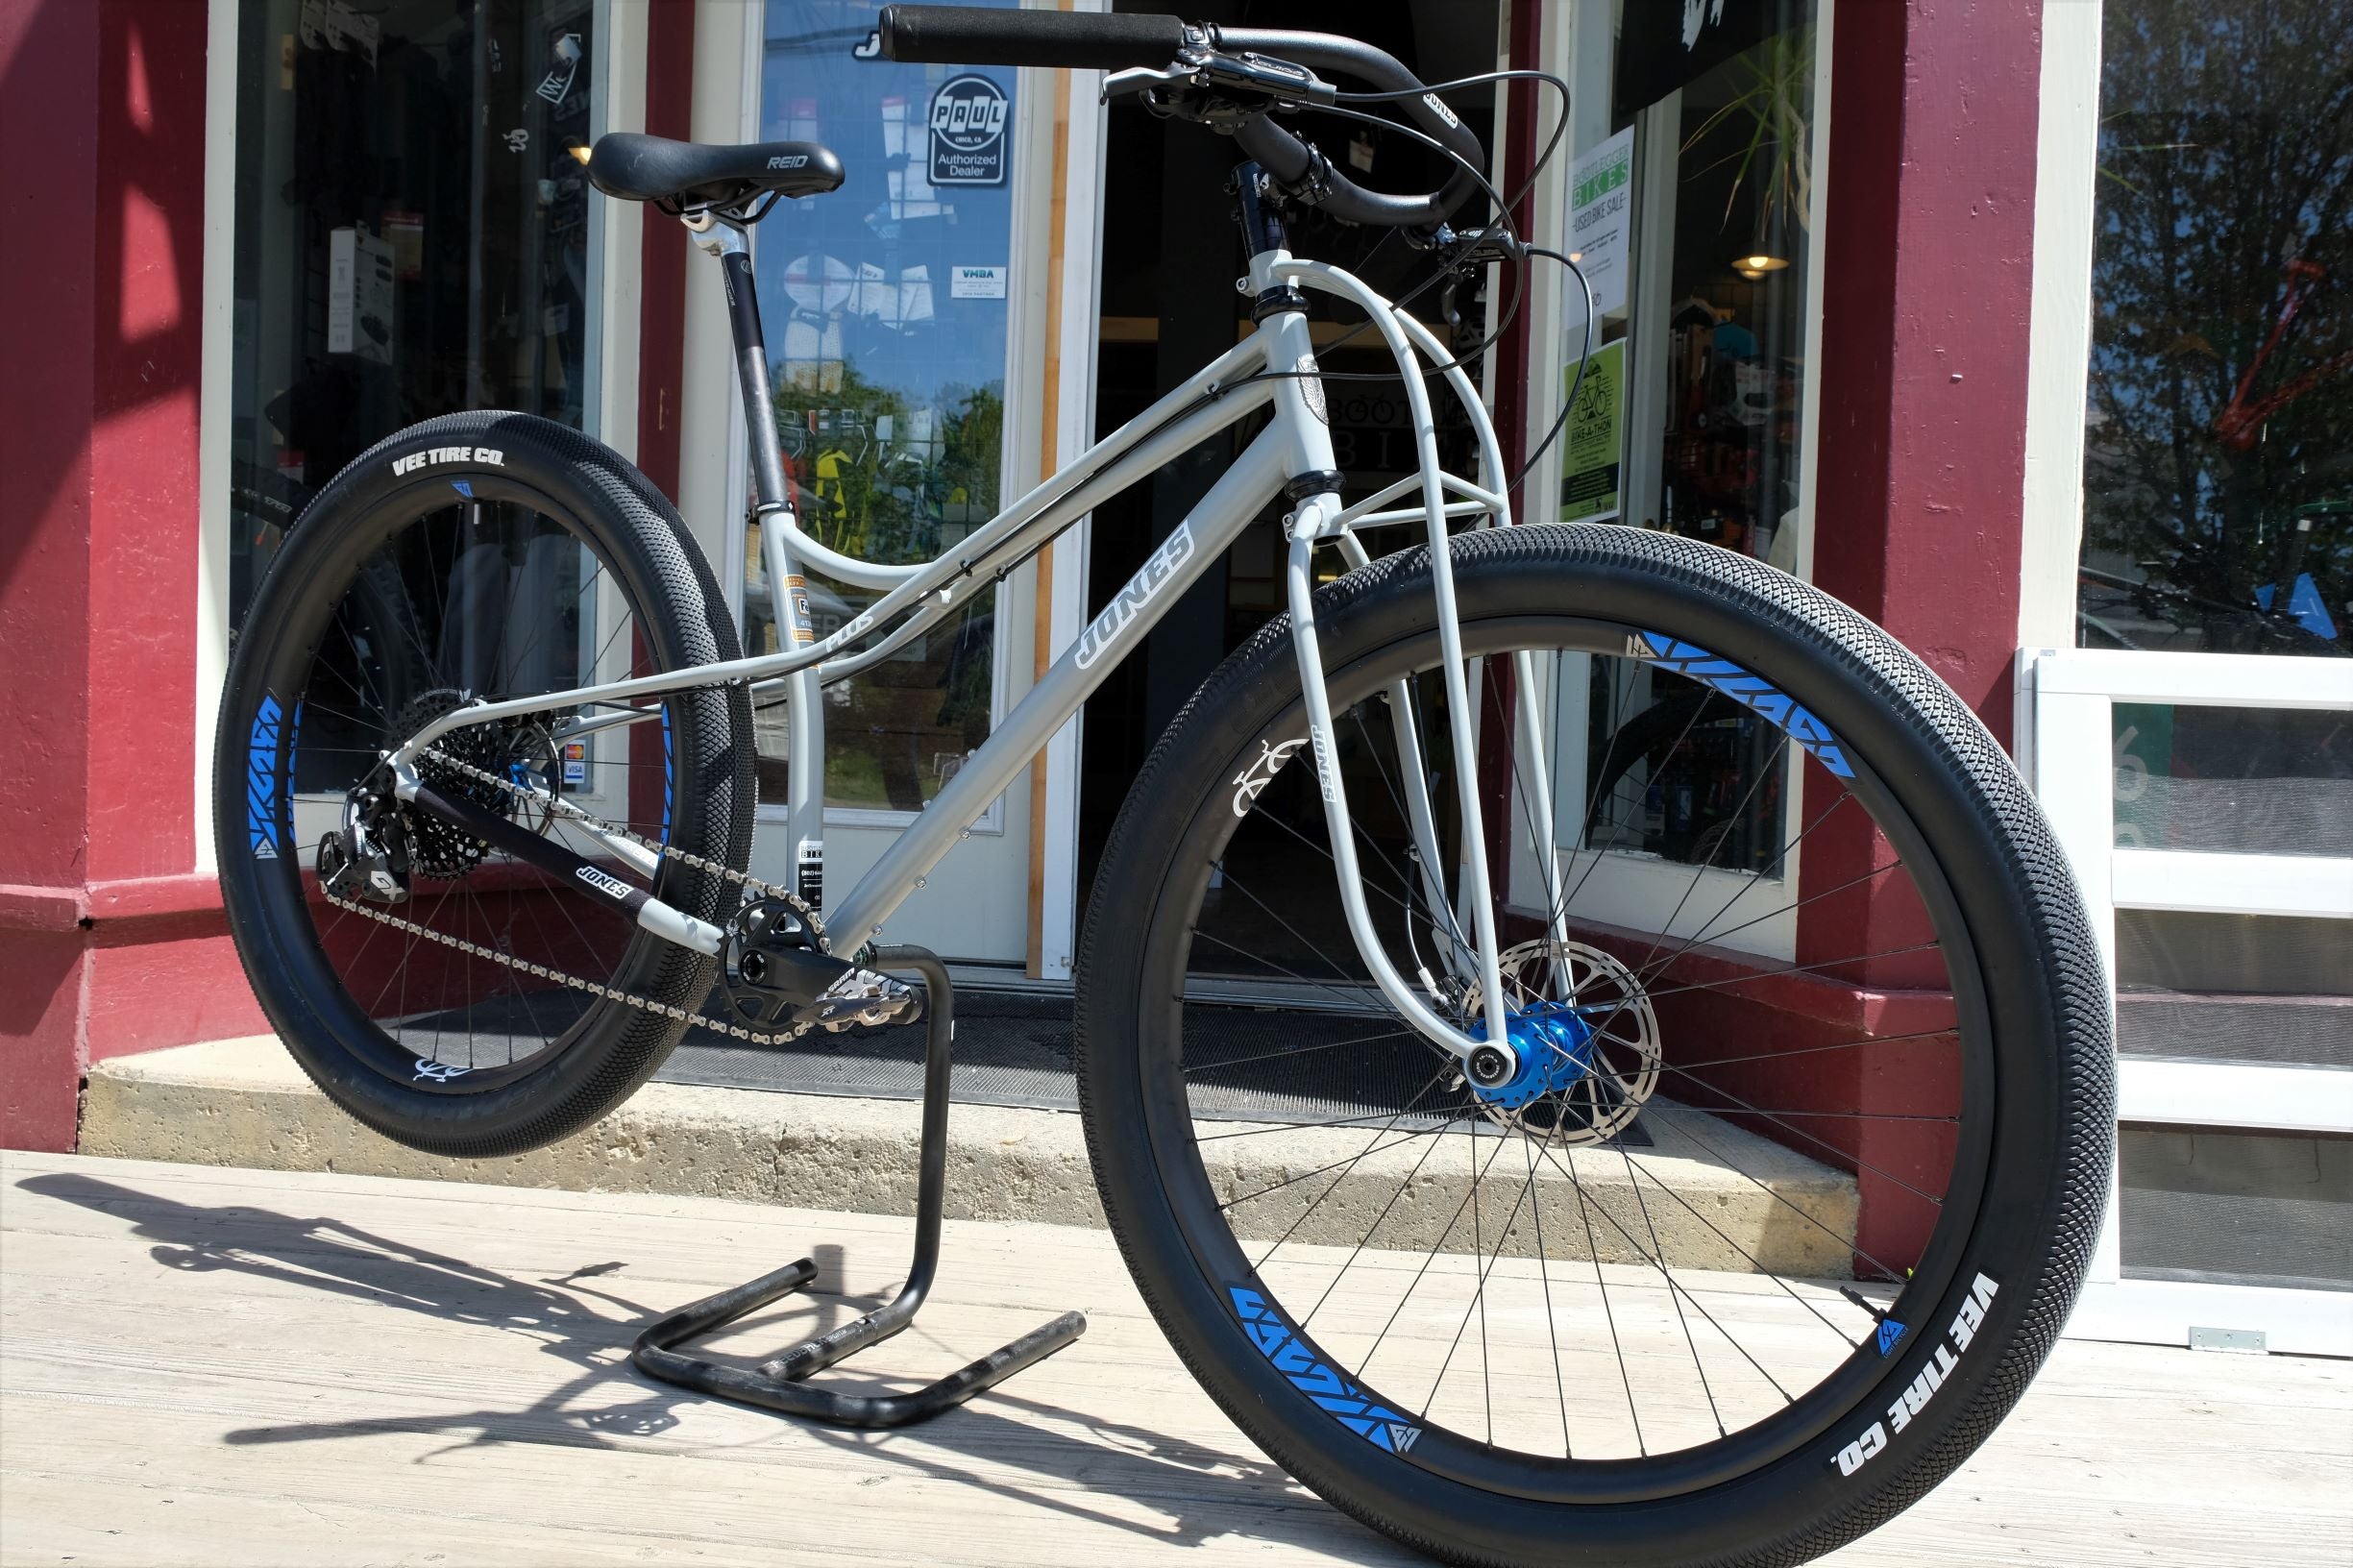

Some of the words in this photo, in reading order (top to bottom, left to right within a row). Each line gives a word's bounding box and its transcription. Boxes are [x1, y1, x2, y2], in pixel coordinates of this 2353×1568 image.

[932, 102, 1004, 125] PAUL
[768, 155, 808, 170] REID
[938, 154, 996, 165] Authorized
[949, 166, 985, 177] Dealer
[1573, 143, 1630, 187] BOOTLEGGER
[1572, 160, 1629, 210] BIKES
[1592, 201, 1606, 225] BIKE
[963, 269, 994, 279] VMBA
[392, 451, 426, 477] VEE
[428, 447, 472, 465] TIRE
[474, 447, 505, 467] CO.
[1075, 521, 1194, 669] JONES
[826, 612, 874, 653] PLUS
[1311, 724, 1337, 802] JONES
[371, 871, 405, 901] GX
[577, 867, 631, 898] JONES
[828, 968, 855, 992] SRAM
[1949, 1271, 1999, 1353] VEE
[1887, 1343, 1959, 1434] TIRE
[1830, 1421, 1888, 1477] CO.
